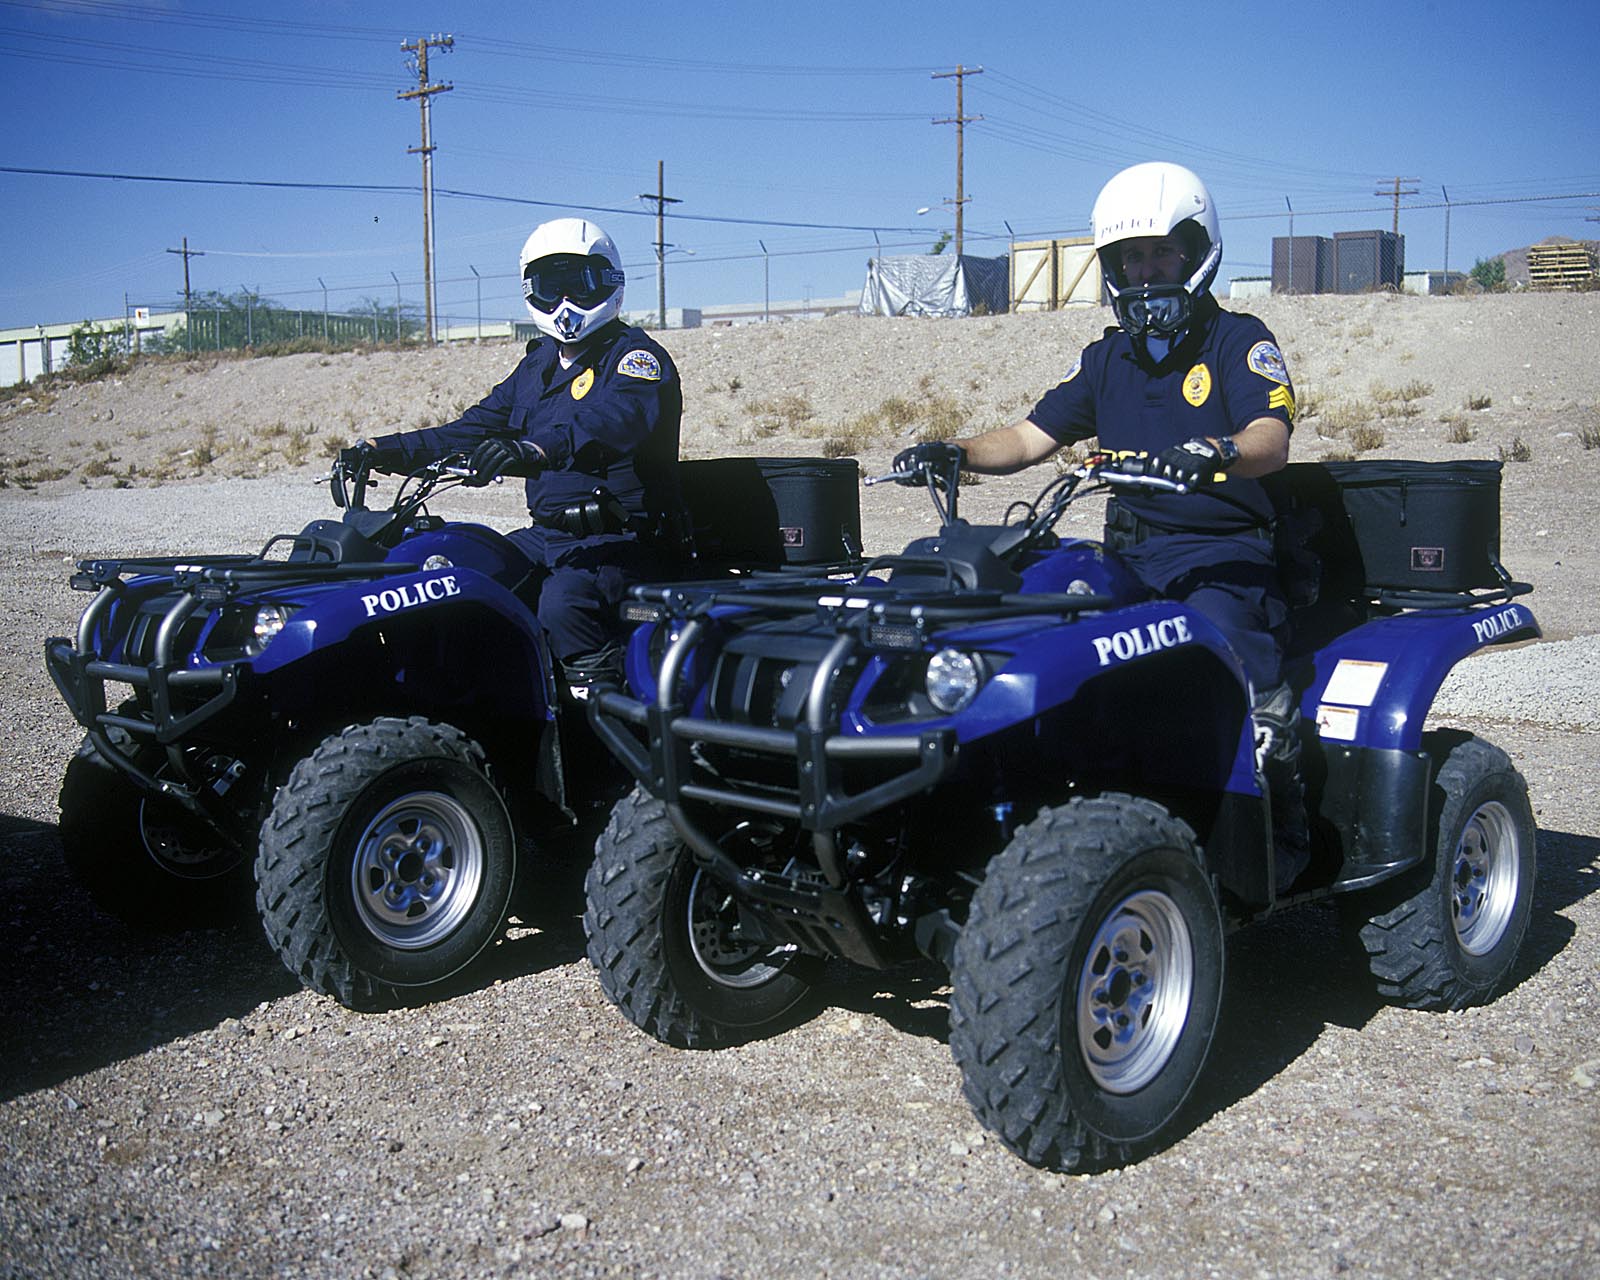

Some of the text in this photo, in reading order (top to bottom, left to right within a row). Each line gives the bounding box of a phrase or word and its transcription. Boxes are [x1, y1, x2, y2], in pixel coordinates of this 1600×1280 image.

[361, 576, 461, 617] POLICE
[1091, 615, 1193, 667] POLICE
[1471, 607, 1523, 643] POLICE
